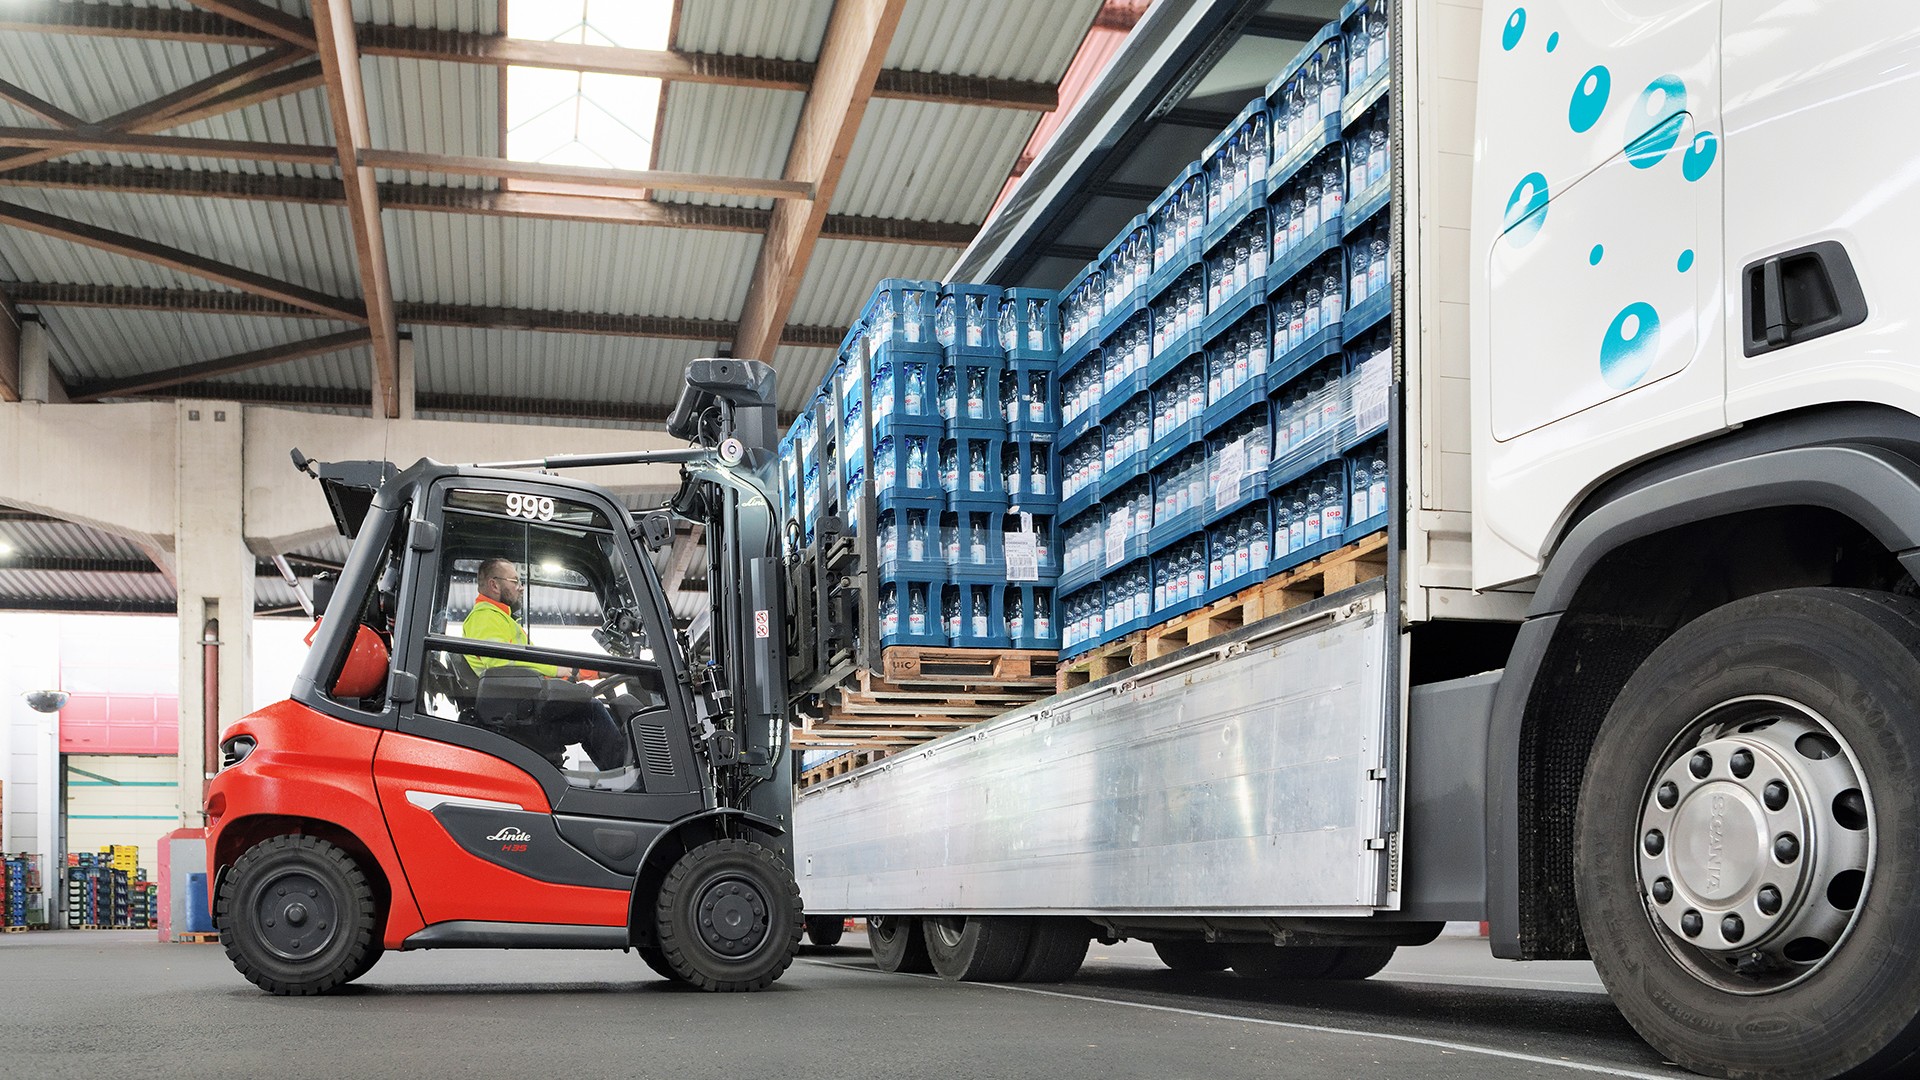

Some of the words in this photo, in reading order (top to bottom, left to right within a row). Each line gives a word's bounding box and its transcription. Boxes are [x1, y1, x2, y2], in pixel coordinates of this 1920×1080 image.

[506, 493, 554, 521] 999
[486, 826, 531, 841] Linde
[1706, 795, 1724, 895] SCANIA
